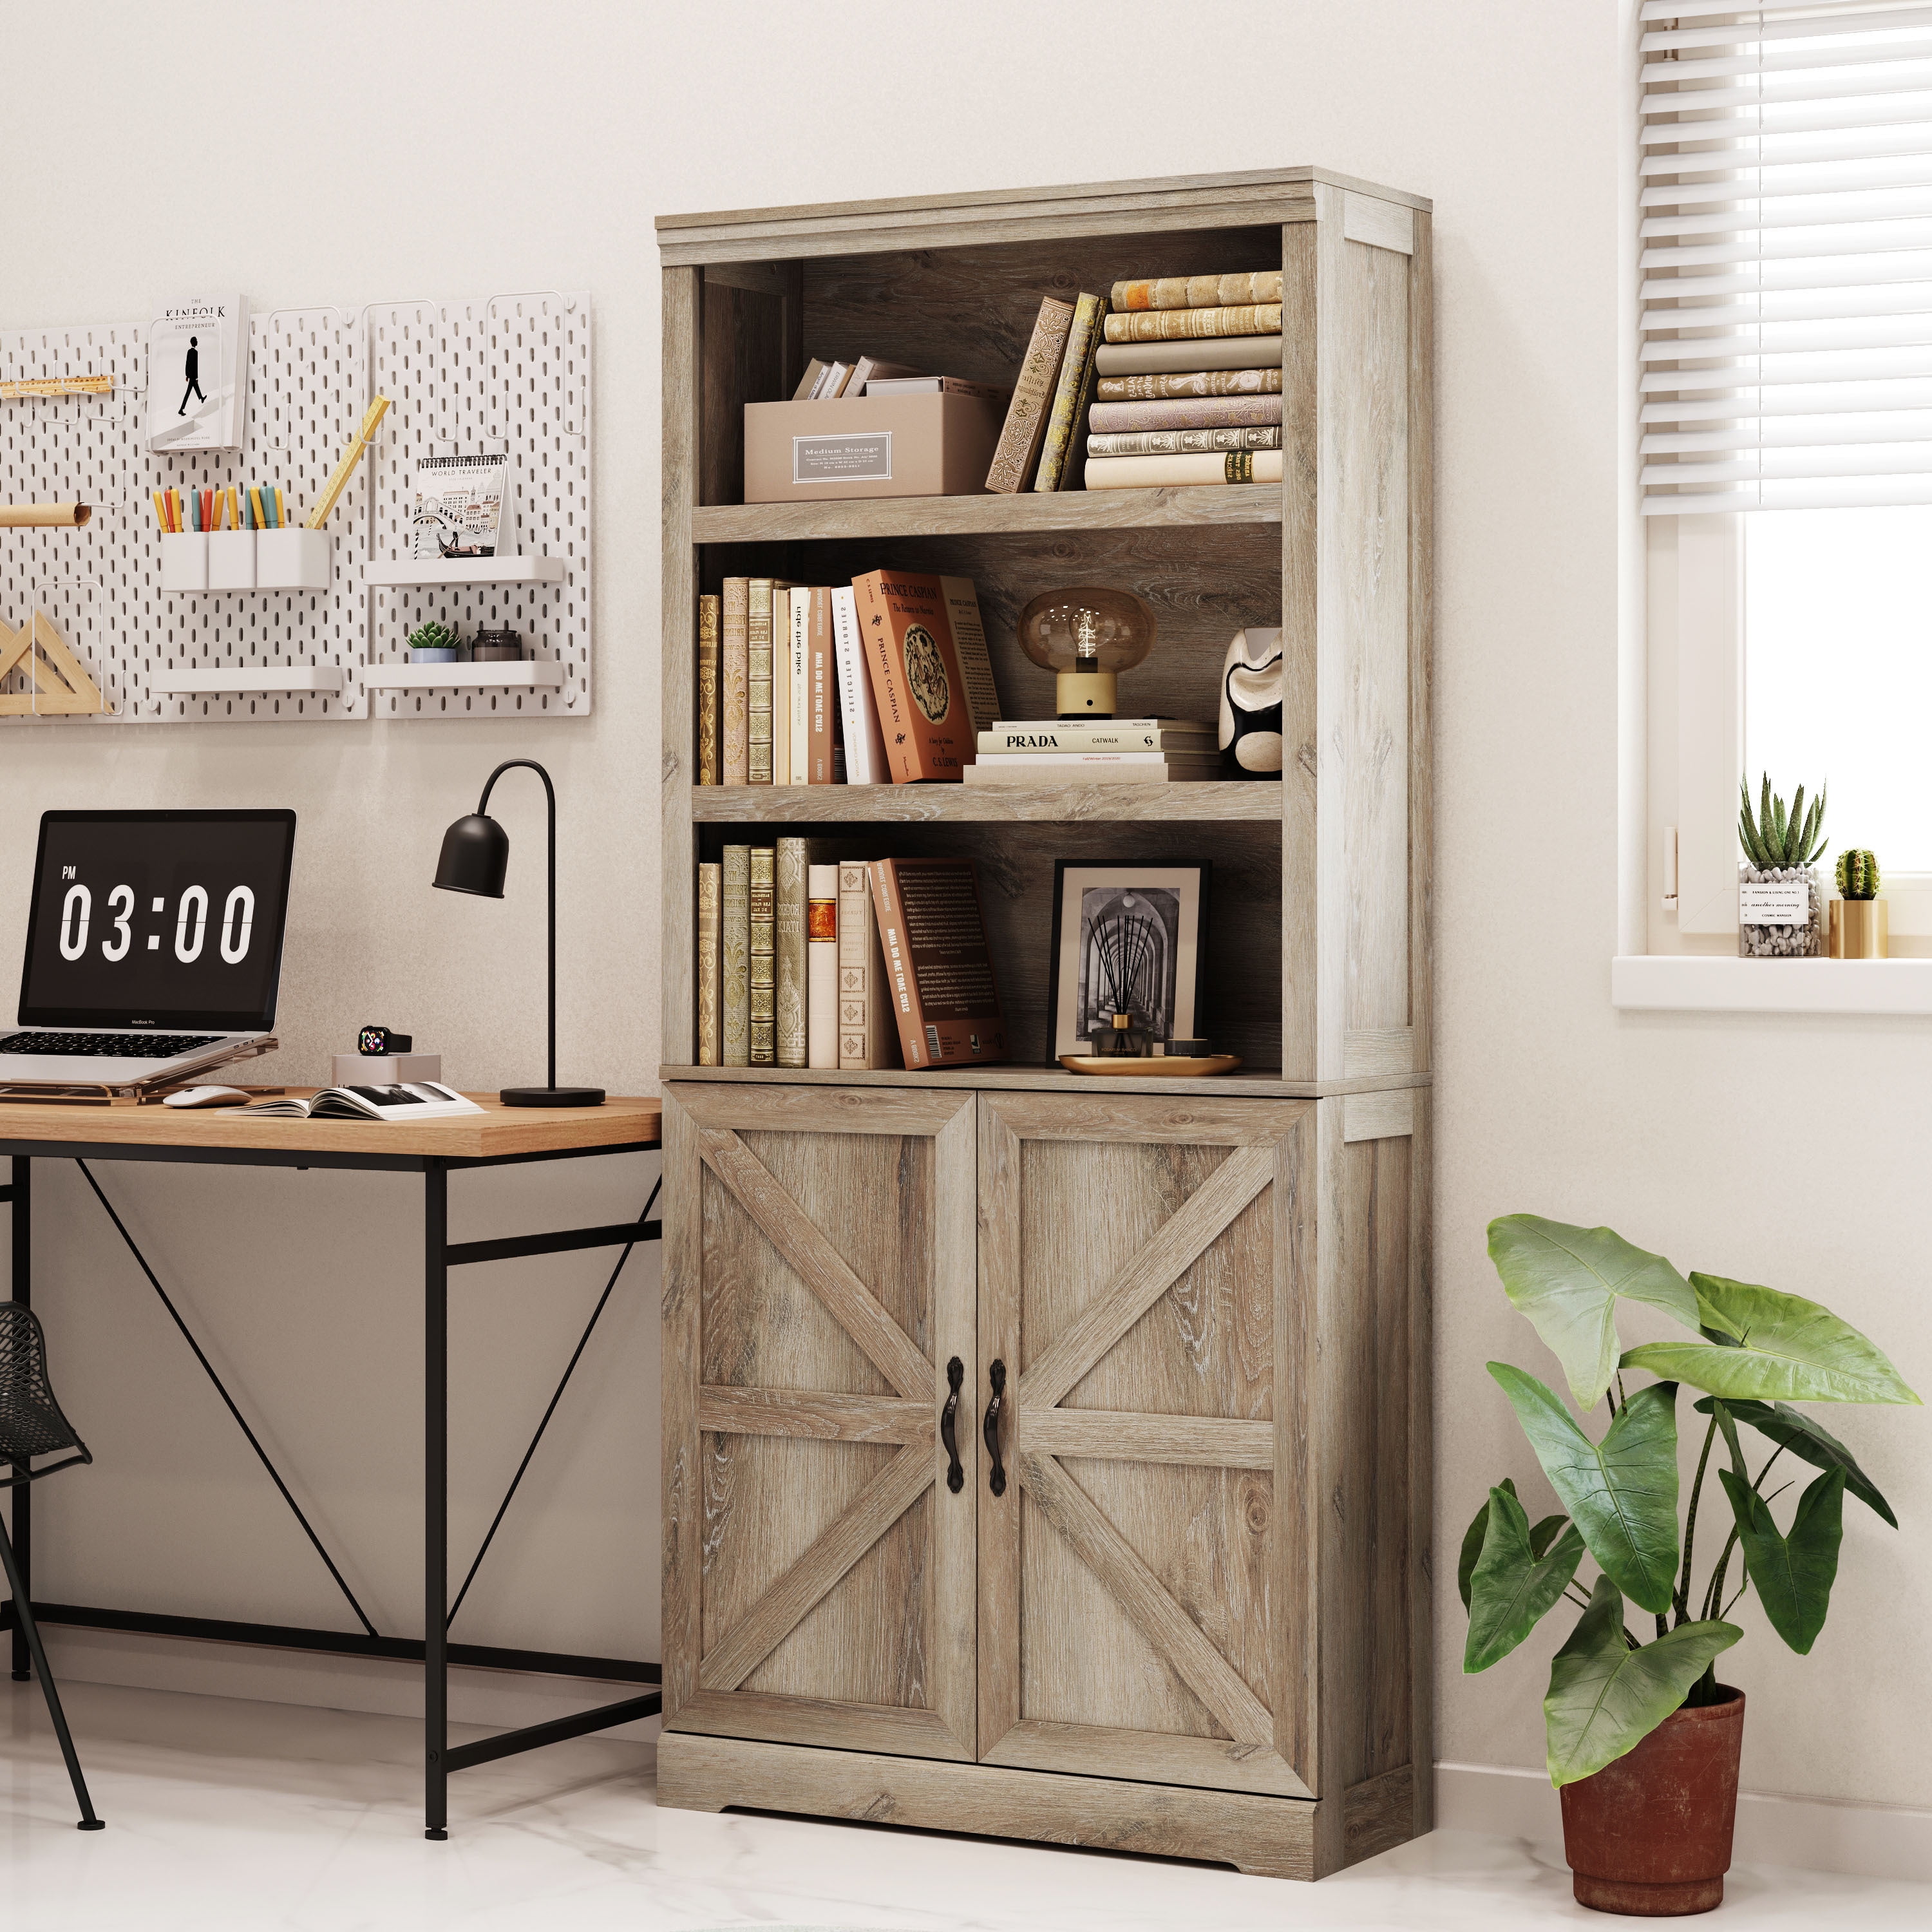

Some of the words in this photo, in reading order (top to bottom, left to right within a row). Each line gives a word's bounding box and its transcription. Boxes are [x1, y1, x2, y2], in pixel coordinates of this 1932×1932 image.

[166, 306, 225, 320] KINFOLK
[829, 371, 840, 390] ERWIN
[880, 582, 908, 597] PRINCE
[909, 585, 937, 599] CASPIAN
[901, 604, 914, 614] Return
[920, 607, 934, 615] Narnia
[877, 637, 890, 675] PRINCE
[886, 679, 900, 724] CASPIAN
[1007, 735, 1058, 747] PRADA
[943, 758, 958, 768] LEWIS
[62, 866, 76, 879] PM
[59, 884, 255, 964] 03:00
